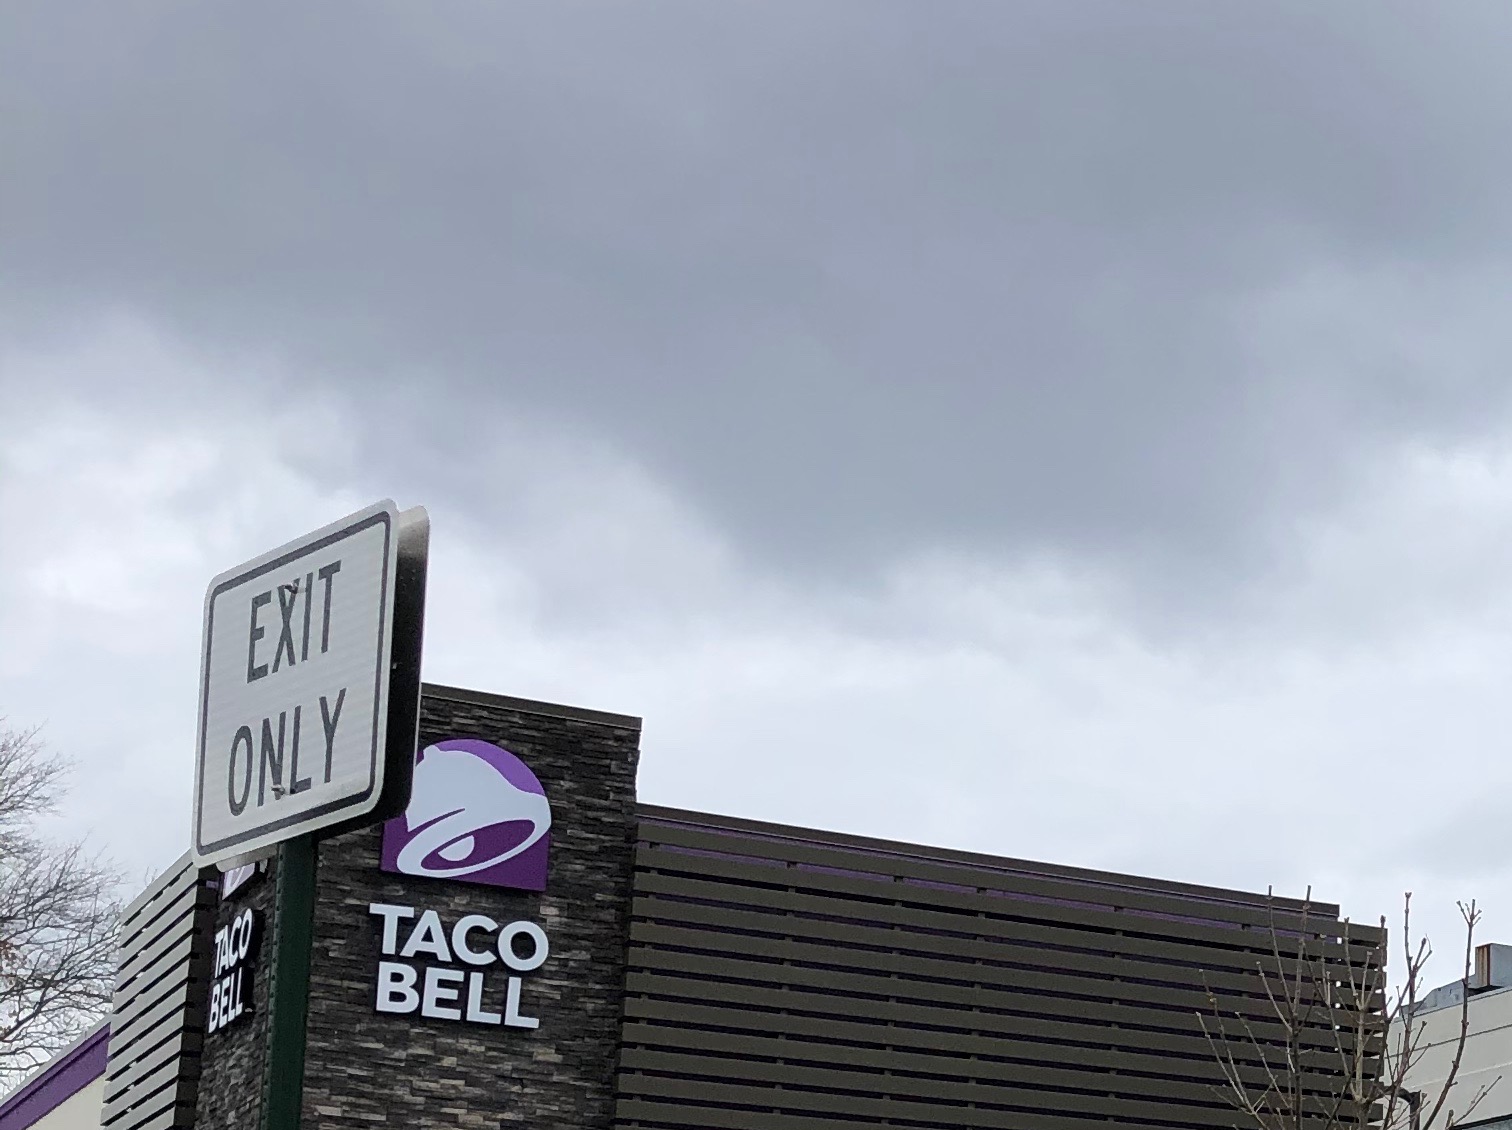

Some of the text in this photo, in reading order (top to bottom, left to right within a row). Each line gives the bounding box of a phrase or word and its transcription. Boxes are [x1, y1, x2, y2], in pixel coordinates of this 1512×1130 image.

[246, 560, 342, 683] EXIT
[228, 688, 347, 816] ONLY
[213, 907, 253, 978] TACO
[369, 903, 550, 972] TACO
[209, 967, 245, 1034] BELL
[375, 963, 540, 1029] BELL
